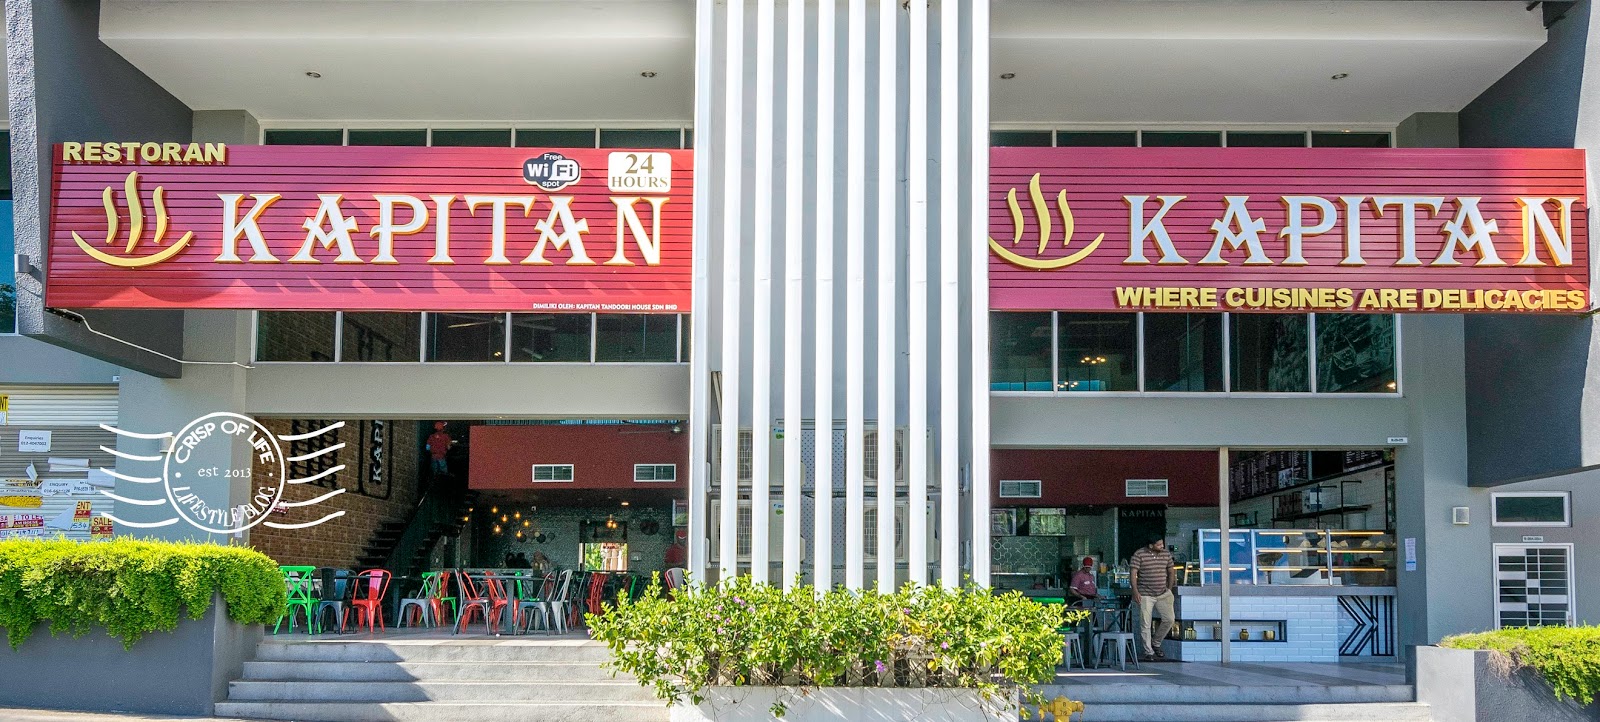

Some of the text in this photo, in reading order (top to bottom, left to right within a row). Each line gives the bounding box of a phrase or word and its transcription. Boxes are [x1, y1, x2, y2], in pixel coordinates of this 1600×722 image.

[63, 142, 226, 163] RESTORAN
[625, 153, 654, 174] 24
[611, 177, 668, 188] HOURS
[214, 193, 671, 266] KAPITAN
[1121, 195, 1580, 266] KAPITAN
[1115, 286, 1586, 310] WHERE CUISINES ARE DELICACIES
[93, 517, 113, 526] SALE
[1121, 509, 1163, 518] KAPITAN
